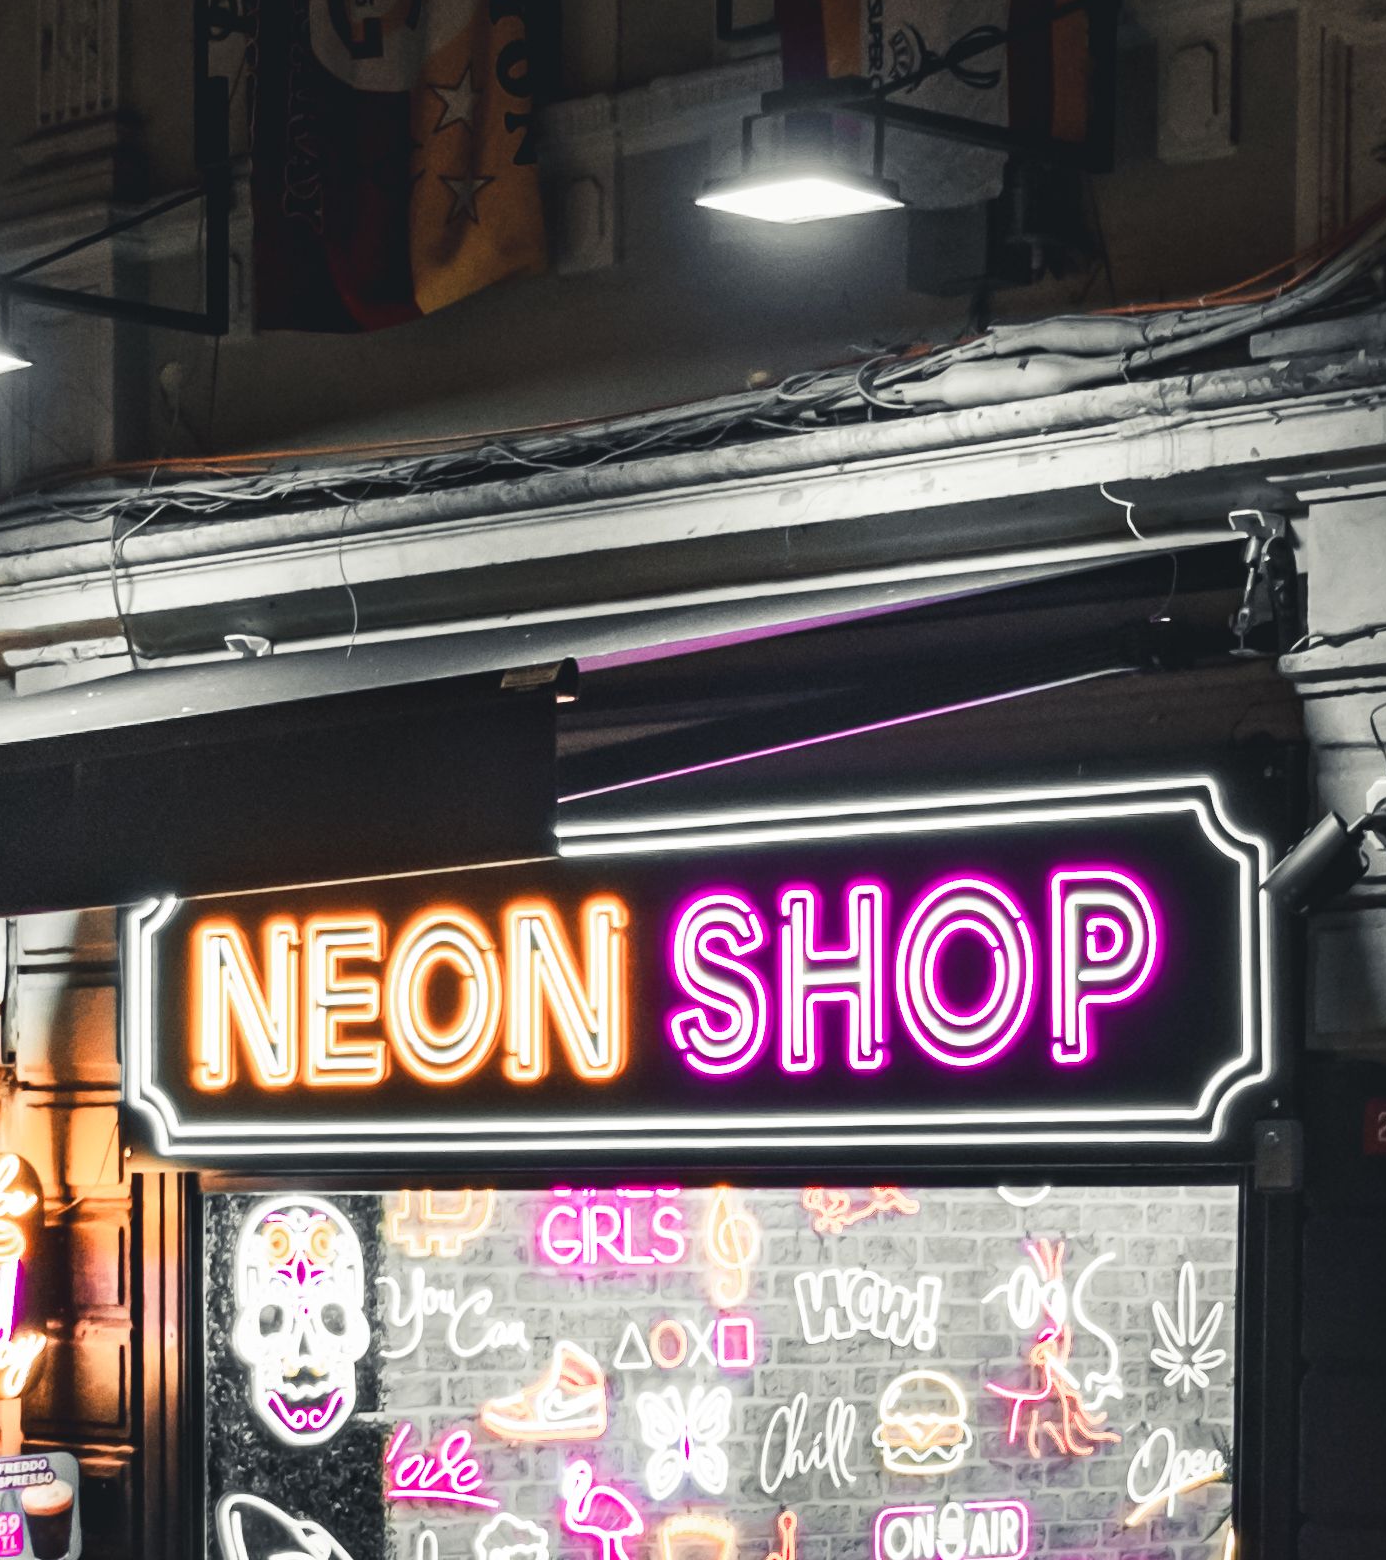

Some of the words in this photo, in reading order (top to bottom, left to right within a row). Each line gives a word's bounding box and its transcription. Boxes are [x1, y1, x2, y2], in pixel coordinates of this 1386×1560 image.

[192, 898, 628, 1090] NEON
[669, 868, 1159, 1075] SHOP
[541, 1205, 685, 1265] GIRLS
[375, 1268, 455, 1359] You
[794, 1267, 943, 1352] WOW!
[759, 1391, 858, 1495] Chill
[1125, 1426, 1227, 1519] Open
[968, 1506, 1020, 1558] AIR
